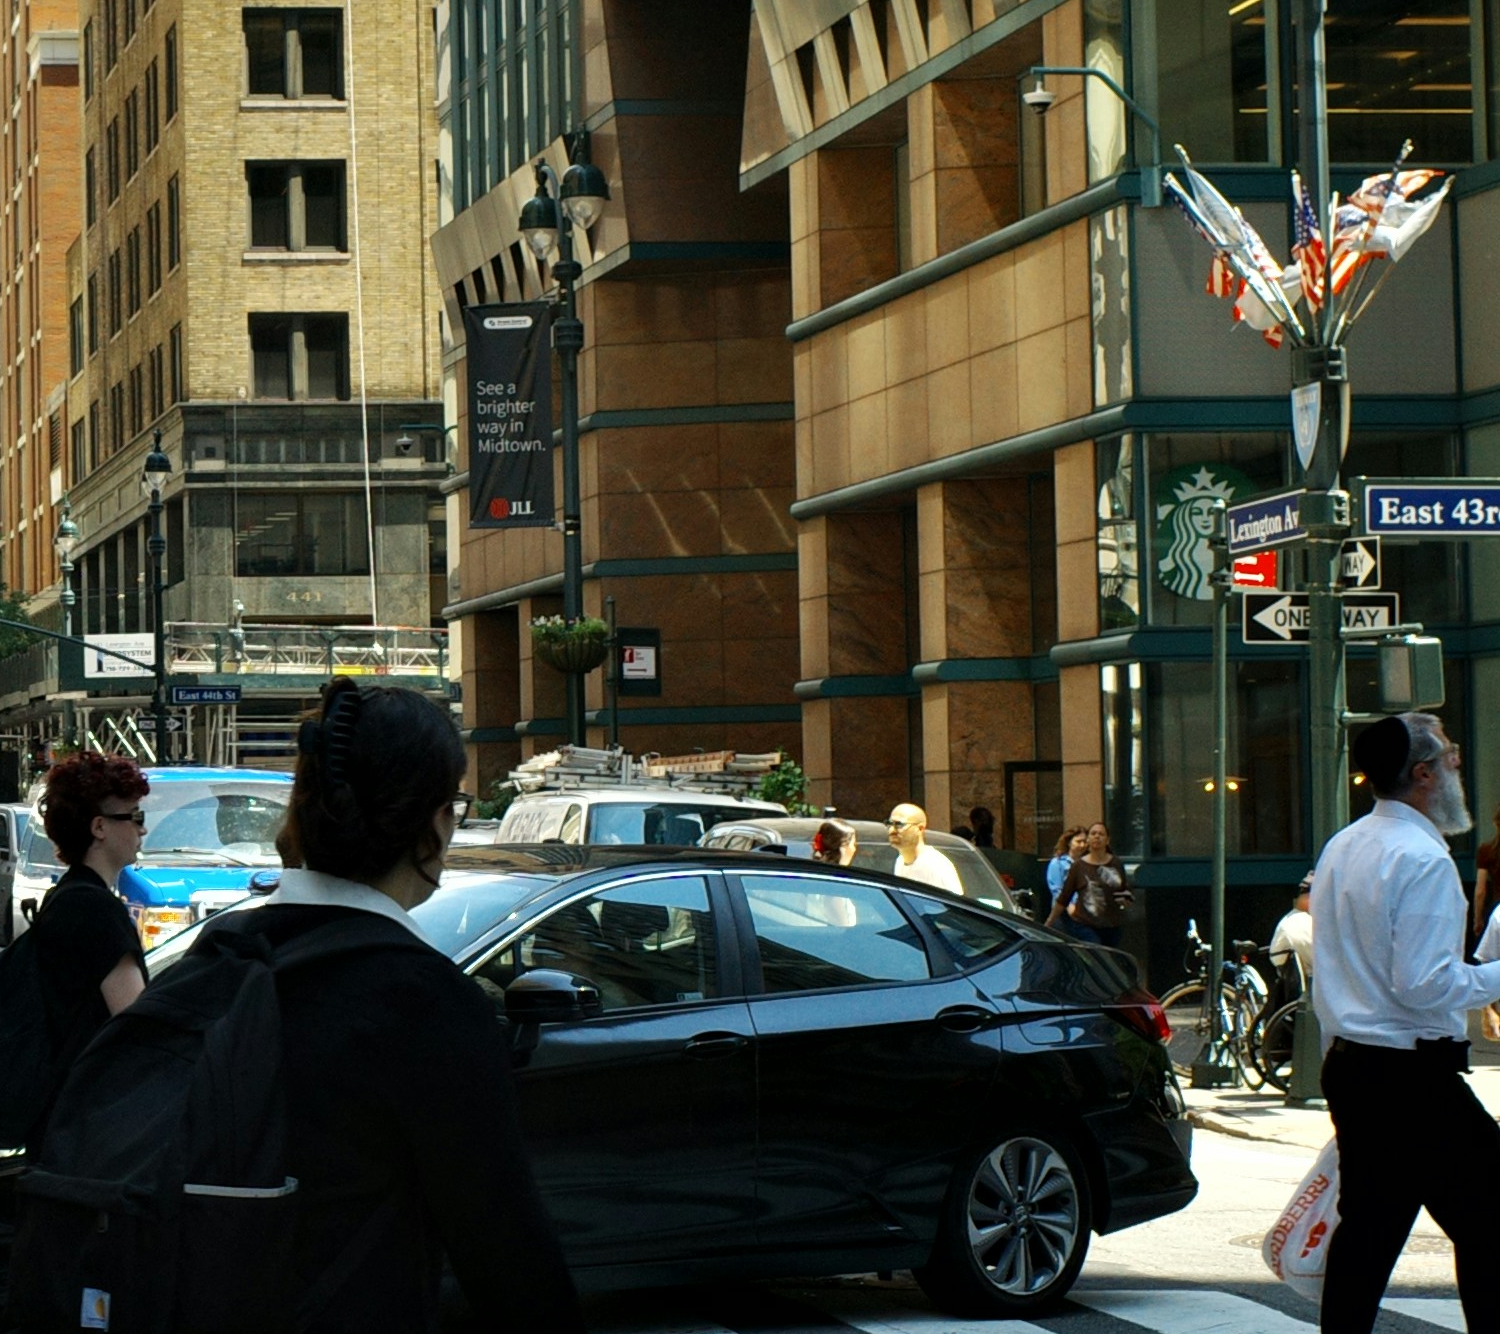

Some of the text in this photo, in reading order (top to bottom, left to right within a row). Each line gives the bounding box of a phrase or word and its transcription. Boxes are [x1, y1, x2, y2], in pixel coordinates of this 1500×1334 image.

[477, 380, 516, 396] See a
[477, 399, 536, 418] brighter
[477, 418, 524, 437] way in
[478, 438, 546, 453] Midtown.
[509, 500, 535, 516] JLL
[1378, 496, 1445, 526] East
[1229, 505, 1282, 543] Lexington
[286, 591, 323, 603] 441
[1275, 609, 1311, 627] ONE
[178, 690, 237, 701] East 44th St
